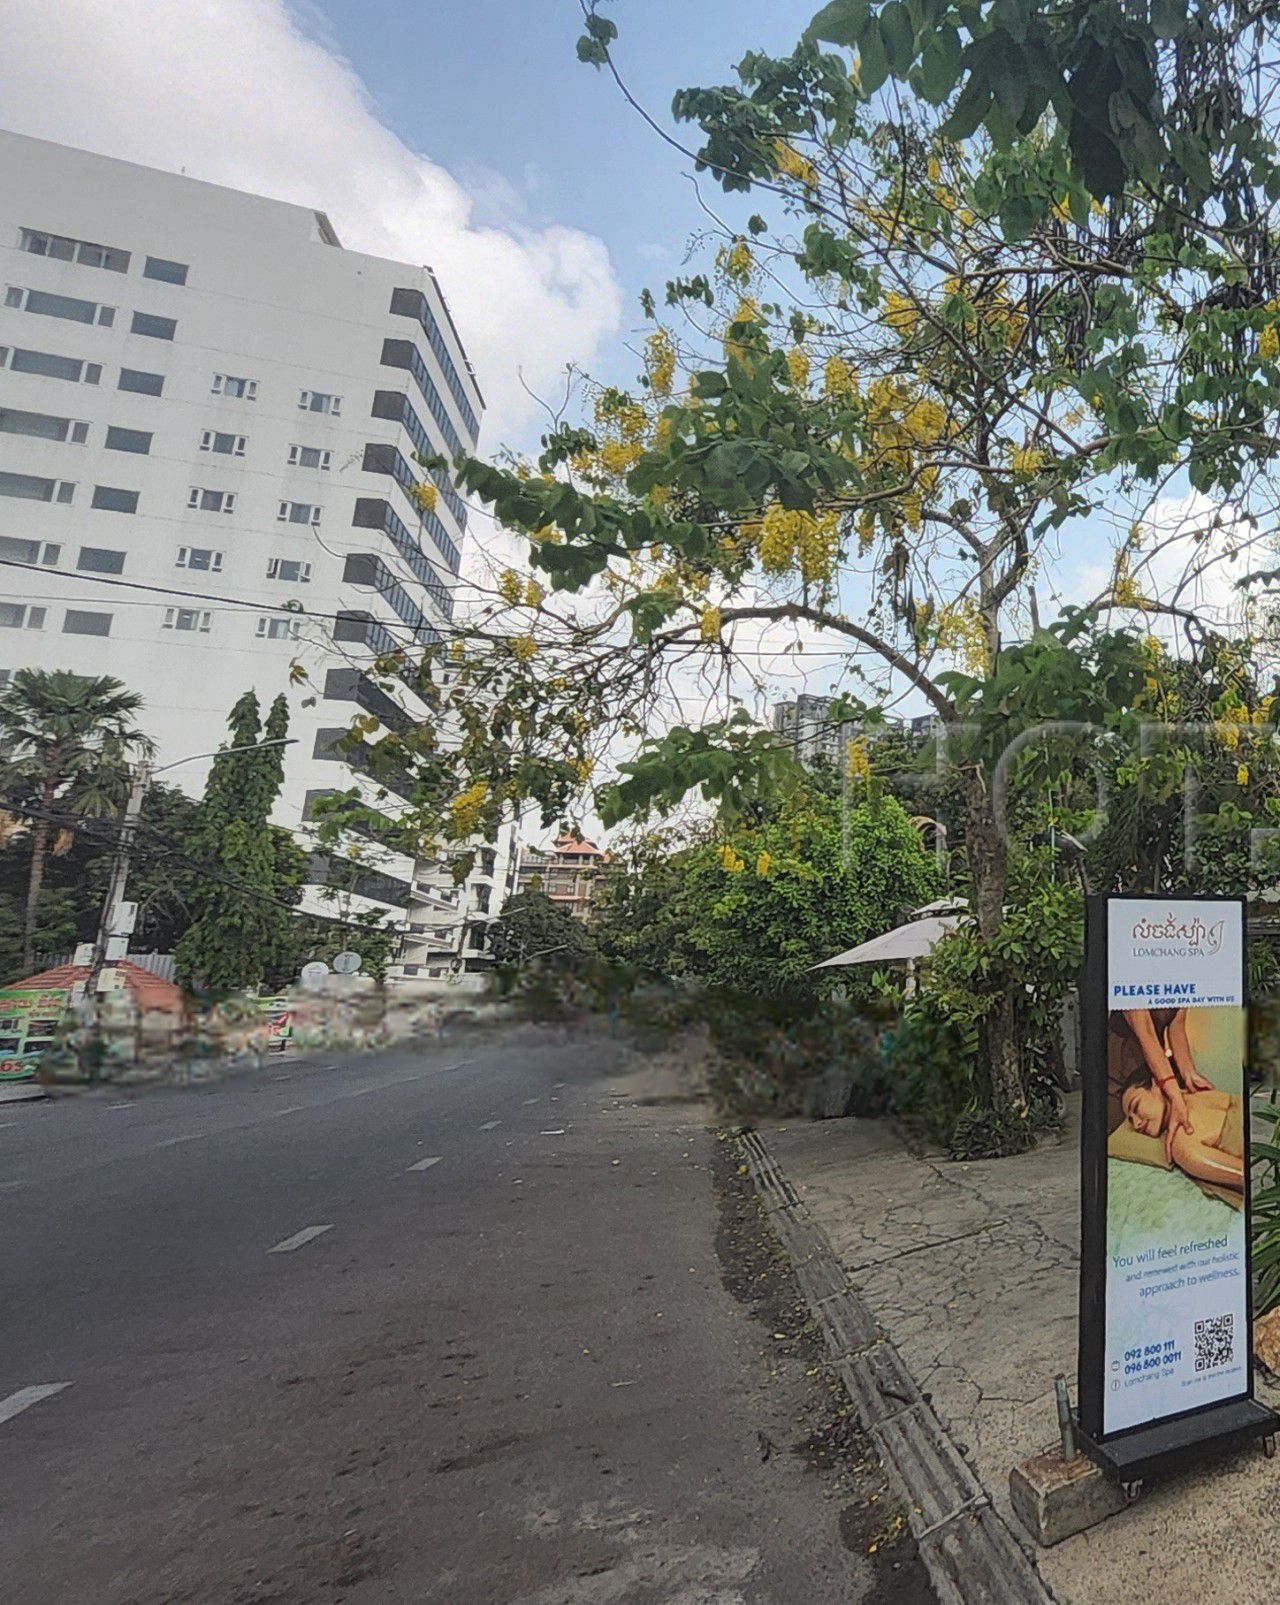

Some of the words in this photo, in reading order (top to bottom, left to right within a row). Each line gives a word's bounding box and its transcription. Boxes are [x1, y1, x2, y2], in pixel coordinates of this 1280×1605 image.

[1133, 947, 1186, 957] LOMCHANG
[1188, 947, 1205, 957] SPA
[1114, 985, 1160, 996] PLEASE
[1164, 984, 1196, 995] HAVE
[1112, 1256, 1133, 1268] You
[1136, 1248, 1155, 1263] will
[1157, 1244, 1178, 1259] feel
[1179, 1235, 1228, 1255] refreshed
[1125, 1271, 1142, 1282] and
[1143, 1264, 1178, 1277] renewed
[1179, 1260, 1196, 1270] with
[1211, 1252, 1240, 1264] holistic
[1139, 1278, 1185, 1298] approach
[1187, 1276, 1197, 1286] to
[1124, 1348, 1142, 1362] 092
[1144, 1343, 1162, 1356] 800
[1163, 1340, 1175, 1351] 111
[1124, 1361, 1142, 1375] 096
[1143, 1356, 1161, 1370] 800
[1162, 1351, 1182, 1365] 0011
[1124, 1371, 1161, 1388] Lomchang
[1161, 1367, 1175, 1377] Spa
